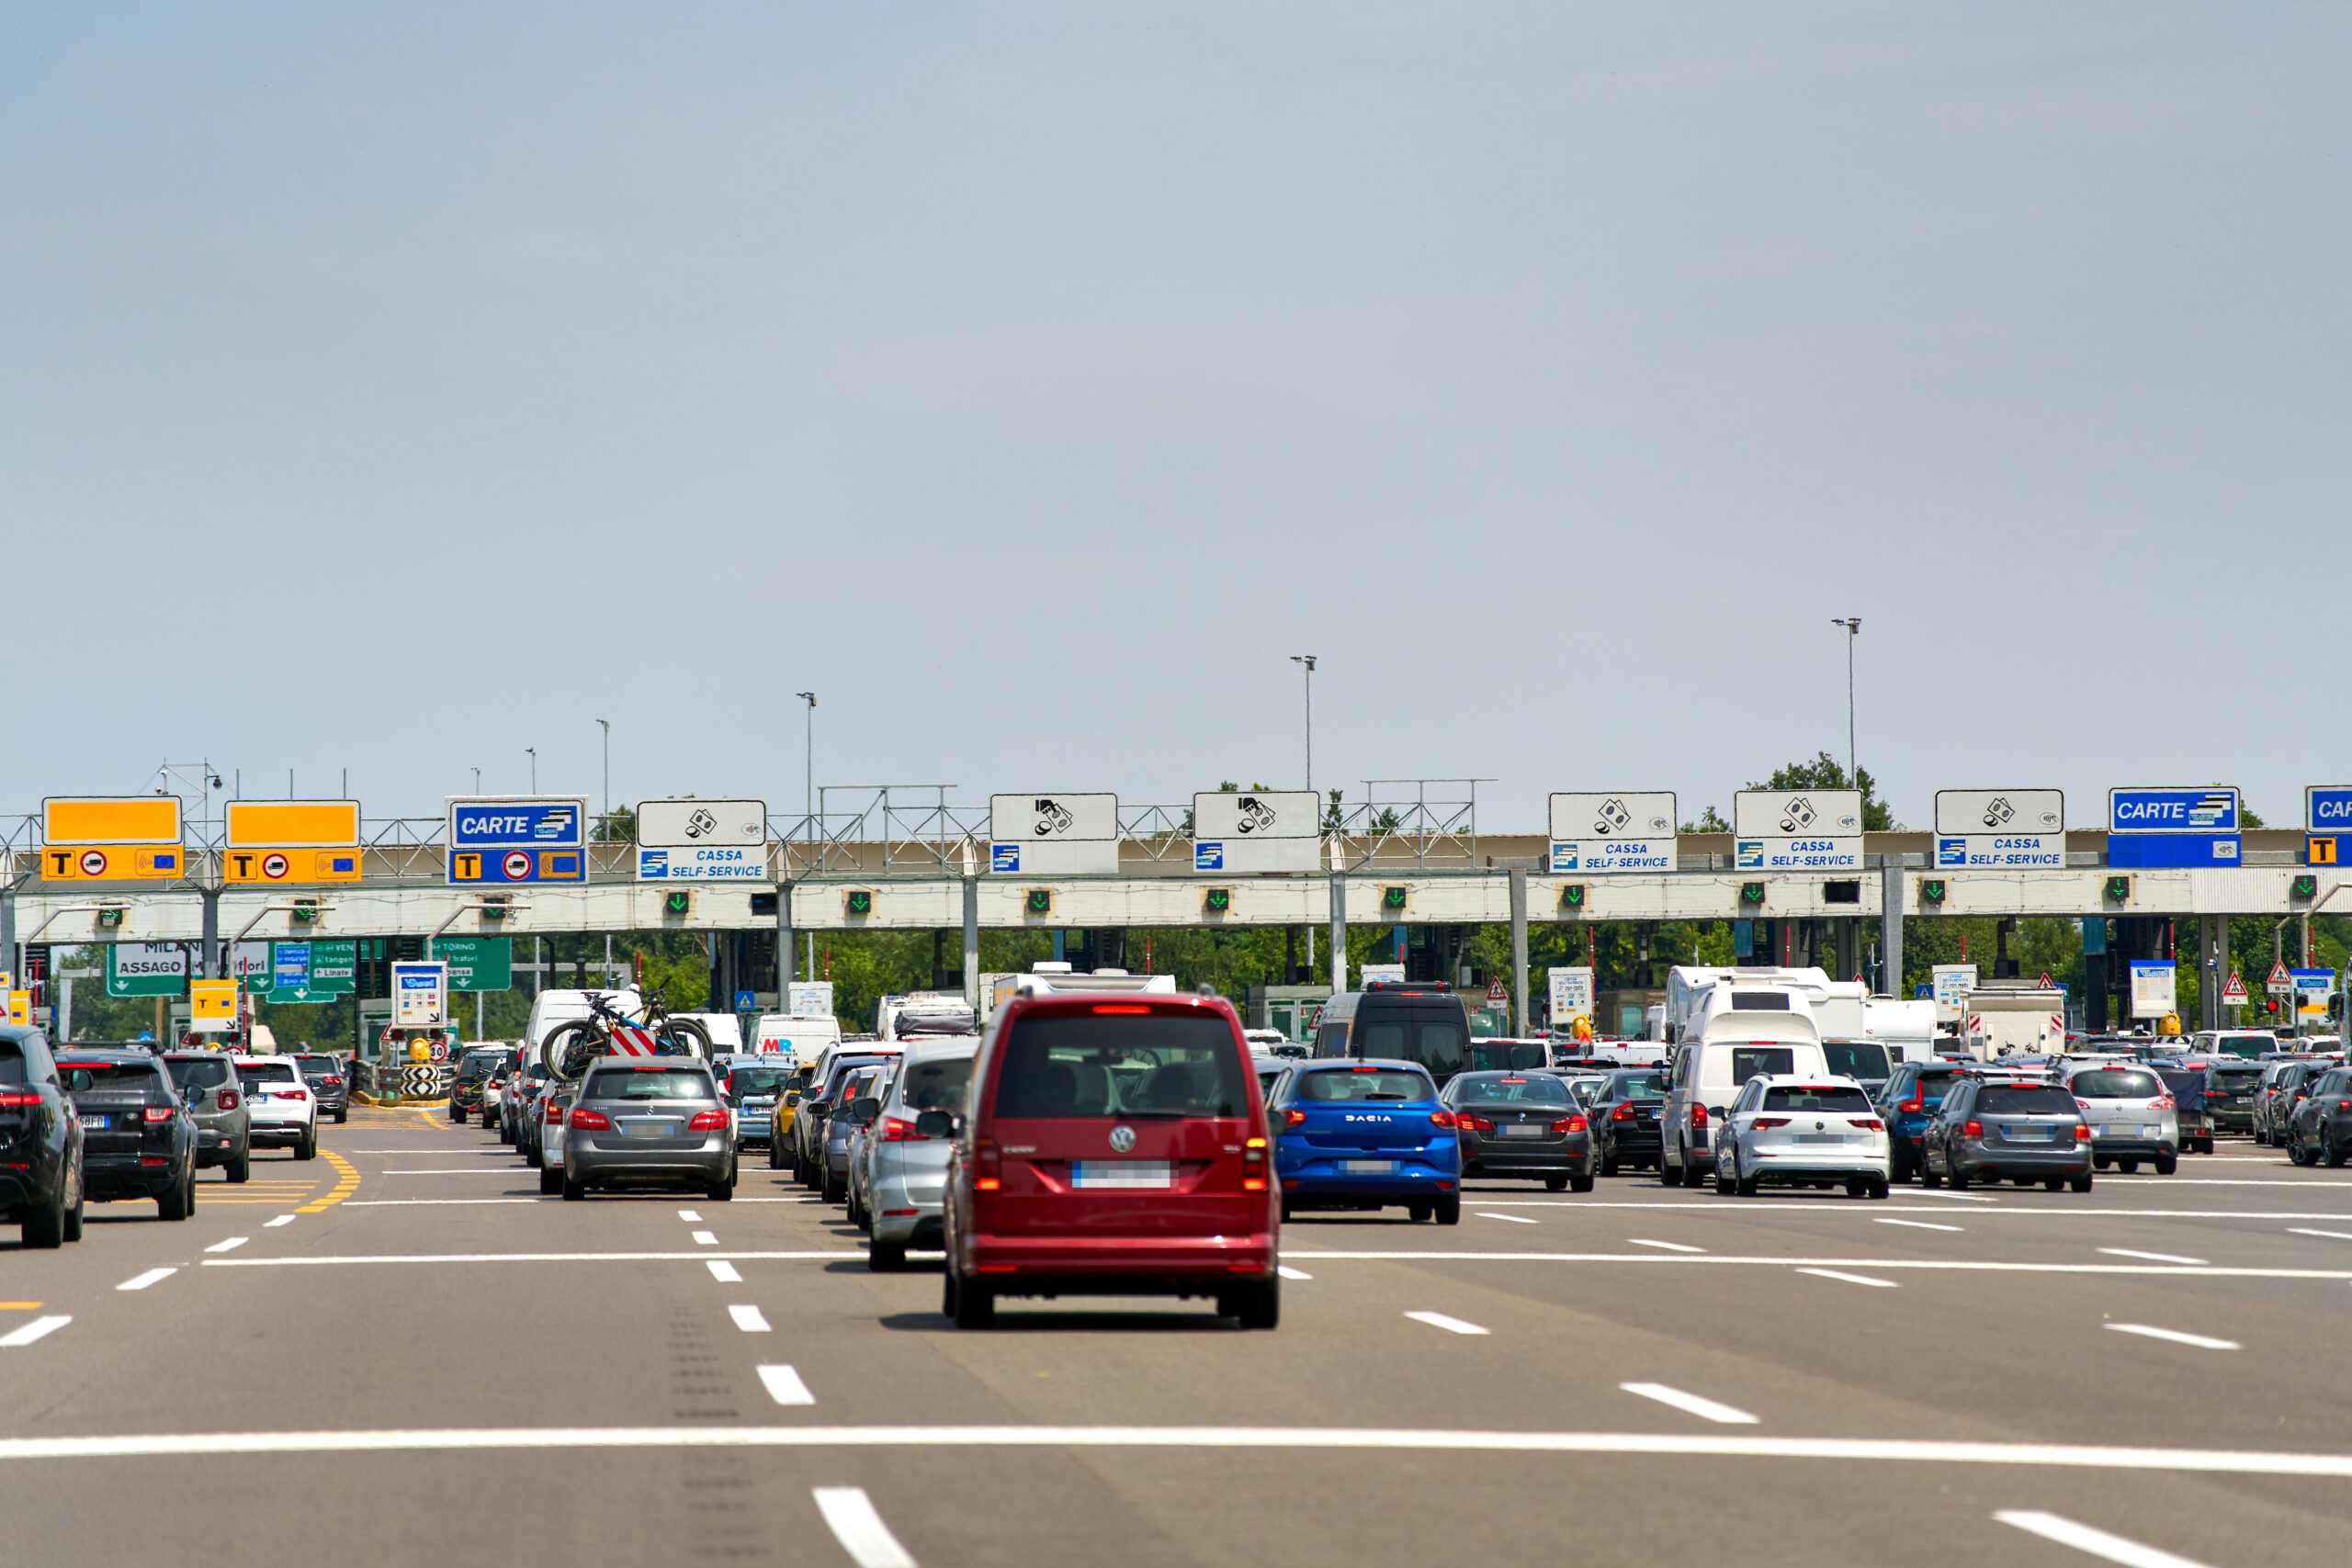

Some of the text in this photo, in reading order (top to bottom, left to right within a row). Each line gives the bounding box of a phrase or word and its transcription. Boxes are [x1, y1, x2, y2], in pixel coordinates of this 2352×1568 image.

[2117, 802, 2186, 819] CARTE
[461, 817, 529, 835] CARTE
[1605, 844, 1647, 854] CASSA
[1791, 841, 1834, 852] CASSA
[1994, 839, 2040, 849] CASSA
[696, 850, 742, 861] CASSA
[2312, 840, 2333, 861] T
[51, 852, 72, 874] T
[1586, 857, 1668, 868] SELF-SERVICE
[1770, 855, 1854, 866] SELF-SERVICE
[1970, 853, 2060, 864] SELF-SERVICE
[232, 856, 254, 877] T
[458, 855, 477, 876] T
[672, 865, 763, 877] SELF-SERVICE
[119, 962, 181, 973] ASSAGO
[198, 999, 207, 1009] T
[430, 1047, 443, 1056] 30
[1345, 1114, 1392, 1122] DACIA
